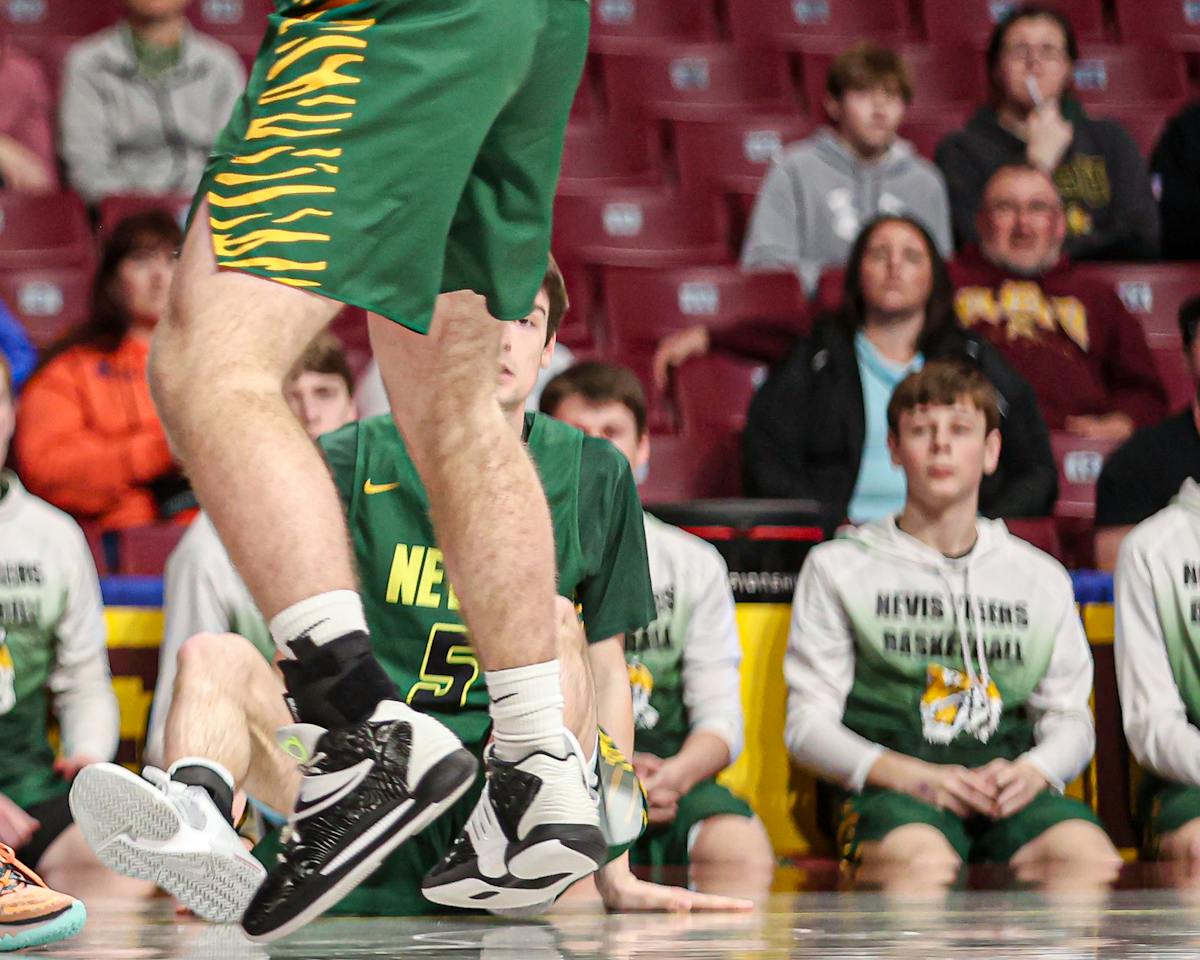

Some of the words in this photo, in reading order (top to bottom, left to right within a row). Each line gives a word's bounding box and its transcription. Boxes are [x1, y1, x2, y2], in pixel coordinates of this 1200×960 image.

[385, 543, 461, 610] NE
[876, 592, 945, 617] NEVIS
[406, 622, 480, 709] 5
